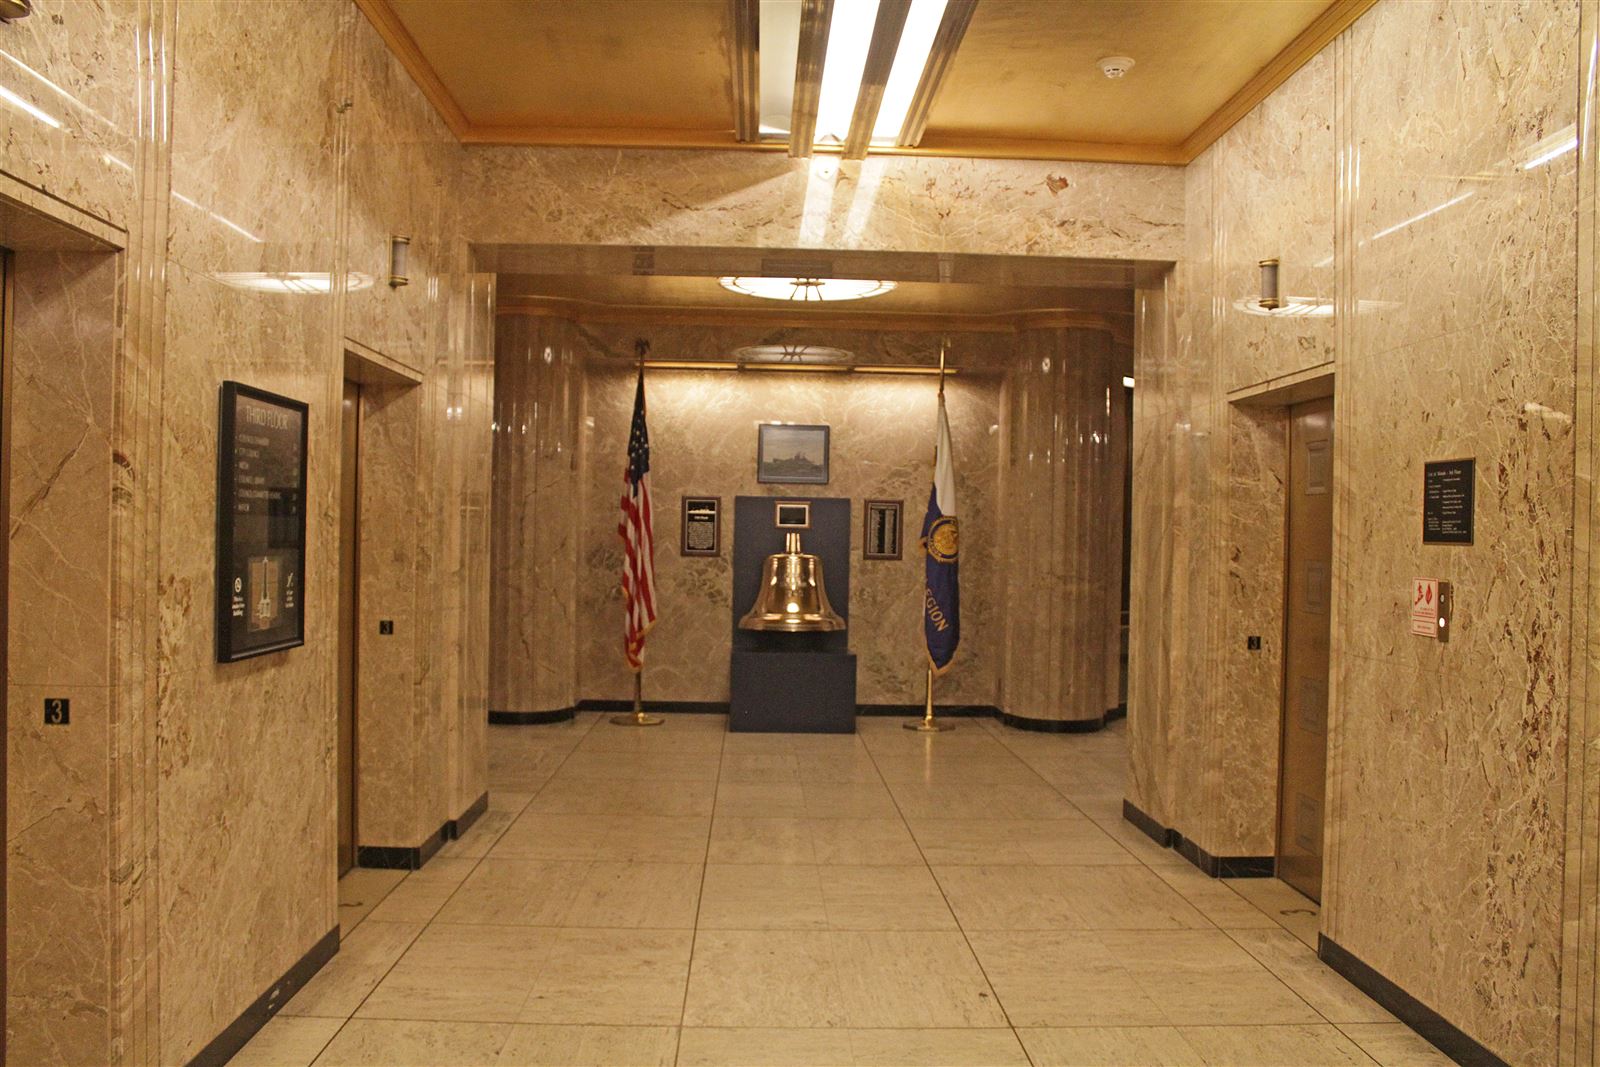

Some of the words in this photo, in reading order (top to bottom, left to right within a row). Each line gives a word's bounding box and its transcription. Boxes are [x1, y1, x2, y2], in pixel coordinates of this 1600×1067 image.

[246, 406, 267, 427] THIRD
[267, 409, 289, 430] FLOOR
[382, 622, 391, 634] 3
[1250, 637, 1258, 649] 3
[51, 700, 62, 723] 3
